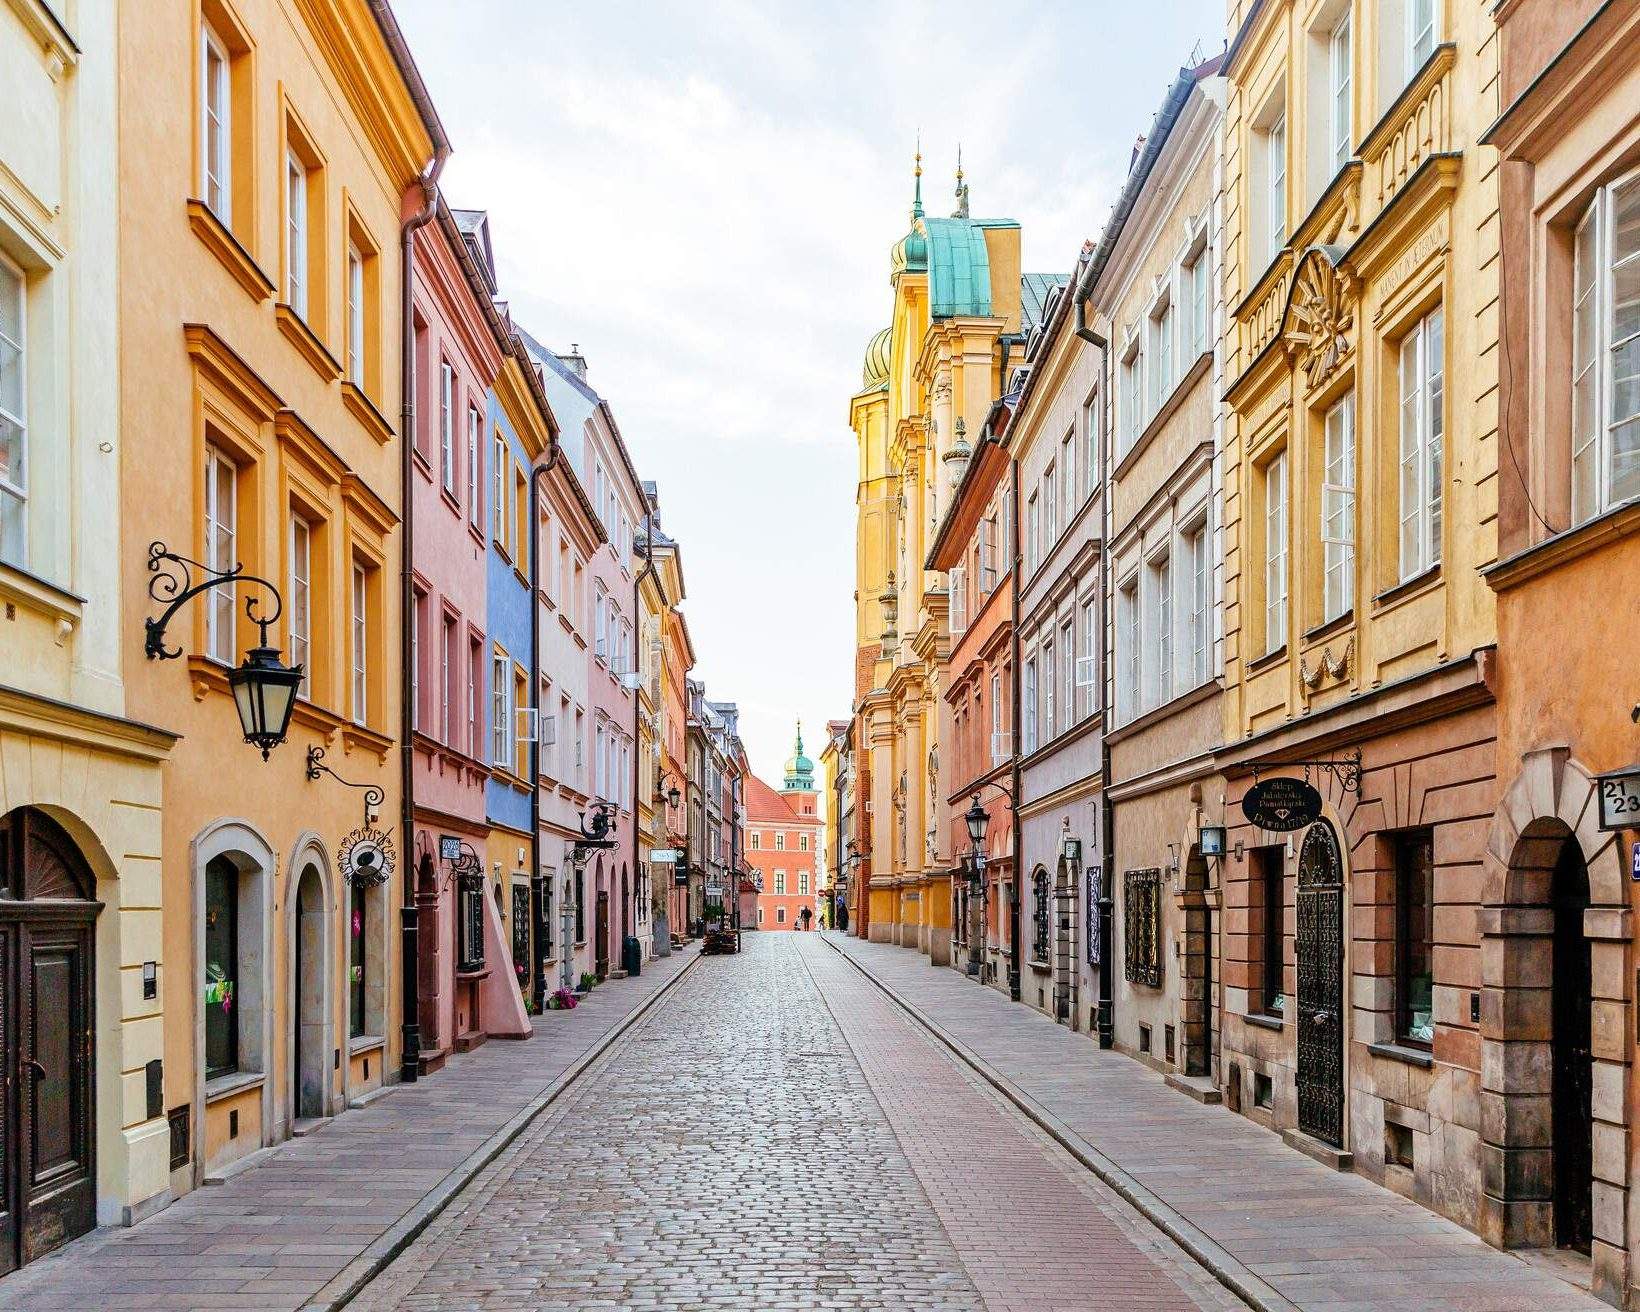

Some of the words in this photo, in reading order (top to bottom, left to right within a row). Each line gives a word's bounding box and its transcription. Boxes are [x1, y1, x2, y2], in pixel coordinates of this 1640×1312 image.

[1271, 781, 1293, 791] Sklep
[1604, 780, 1626, 798] 21
[1613, 795, 1640, 813] 23
